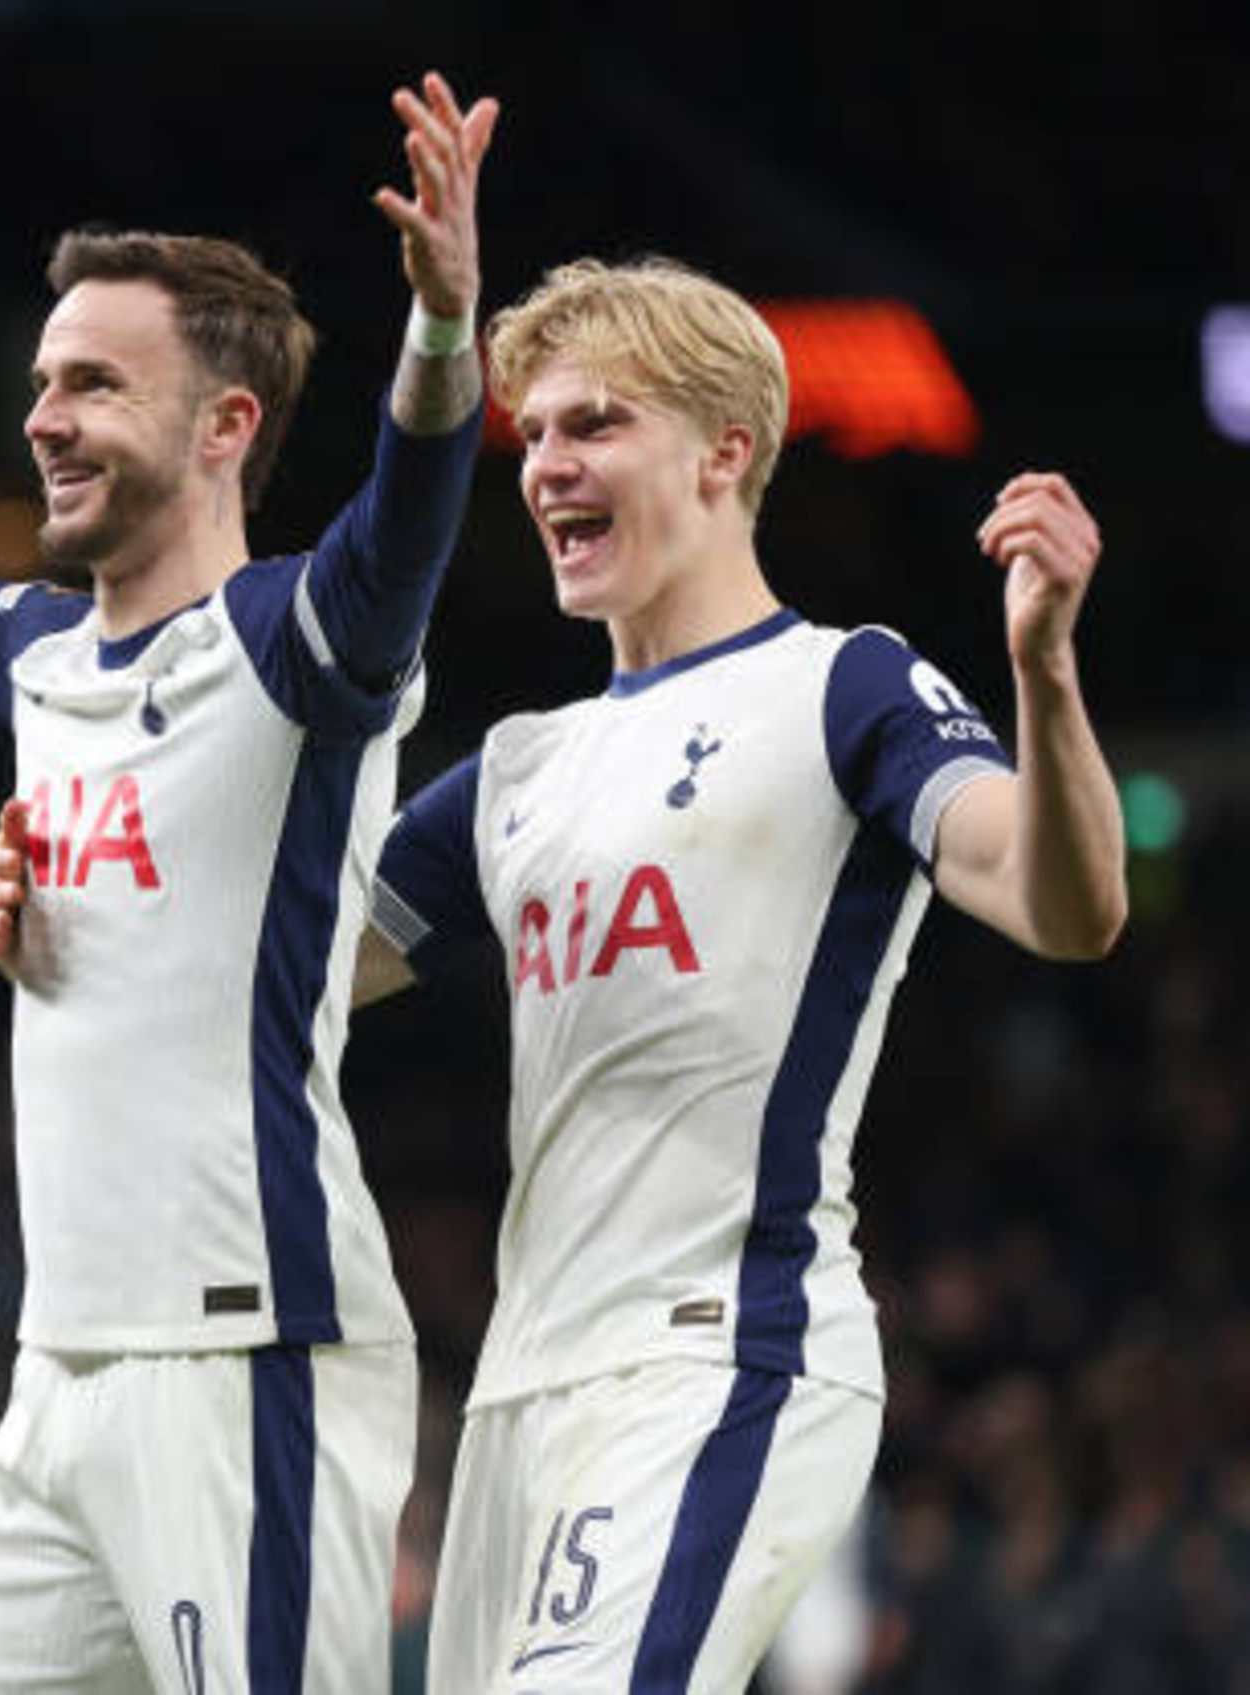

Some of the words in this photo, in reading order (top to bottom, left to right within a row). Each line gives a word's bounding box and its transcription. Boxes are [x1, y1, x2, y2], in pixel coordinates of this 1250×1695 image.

[22, 773, 161, 889] AIA
[515, 862, 700, 1000] AIA
[527, 1506, 614, 1626] 15
